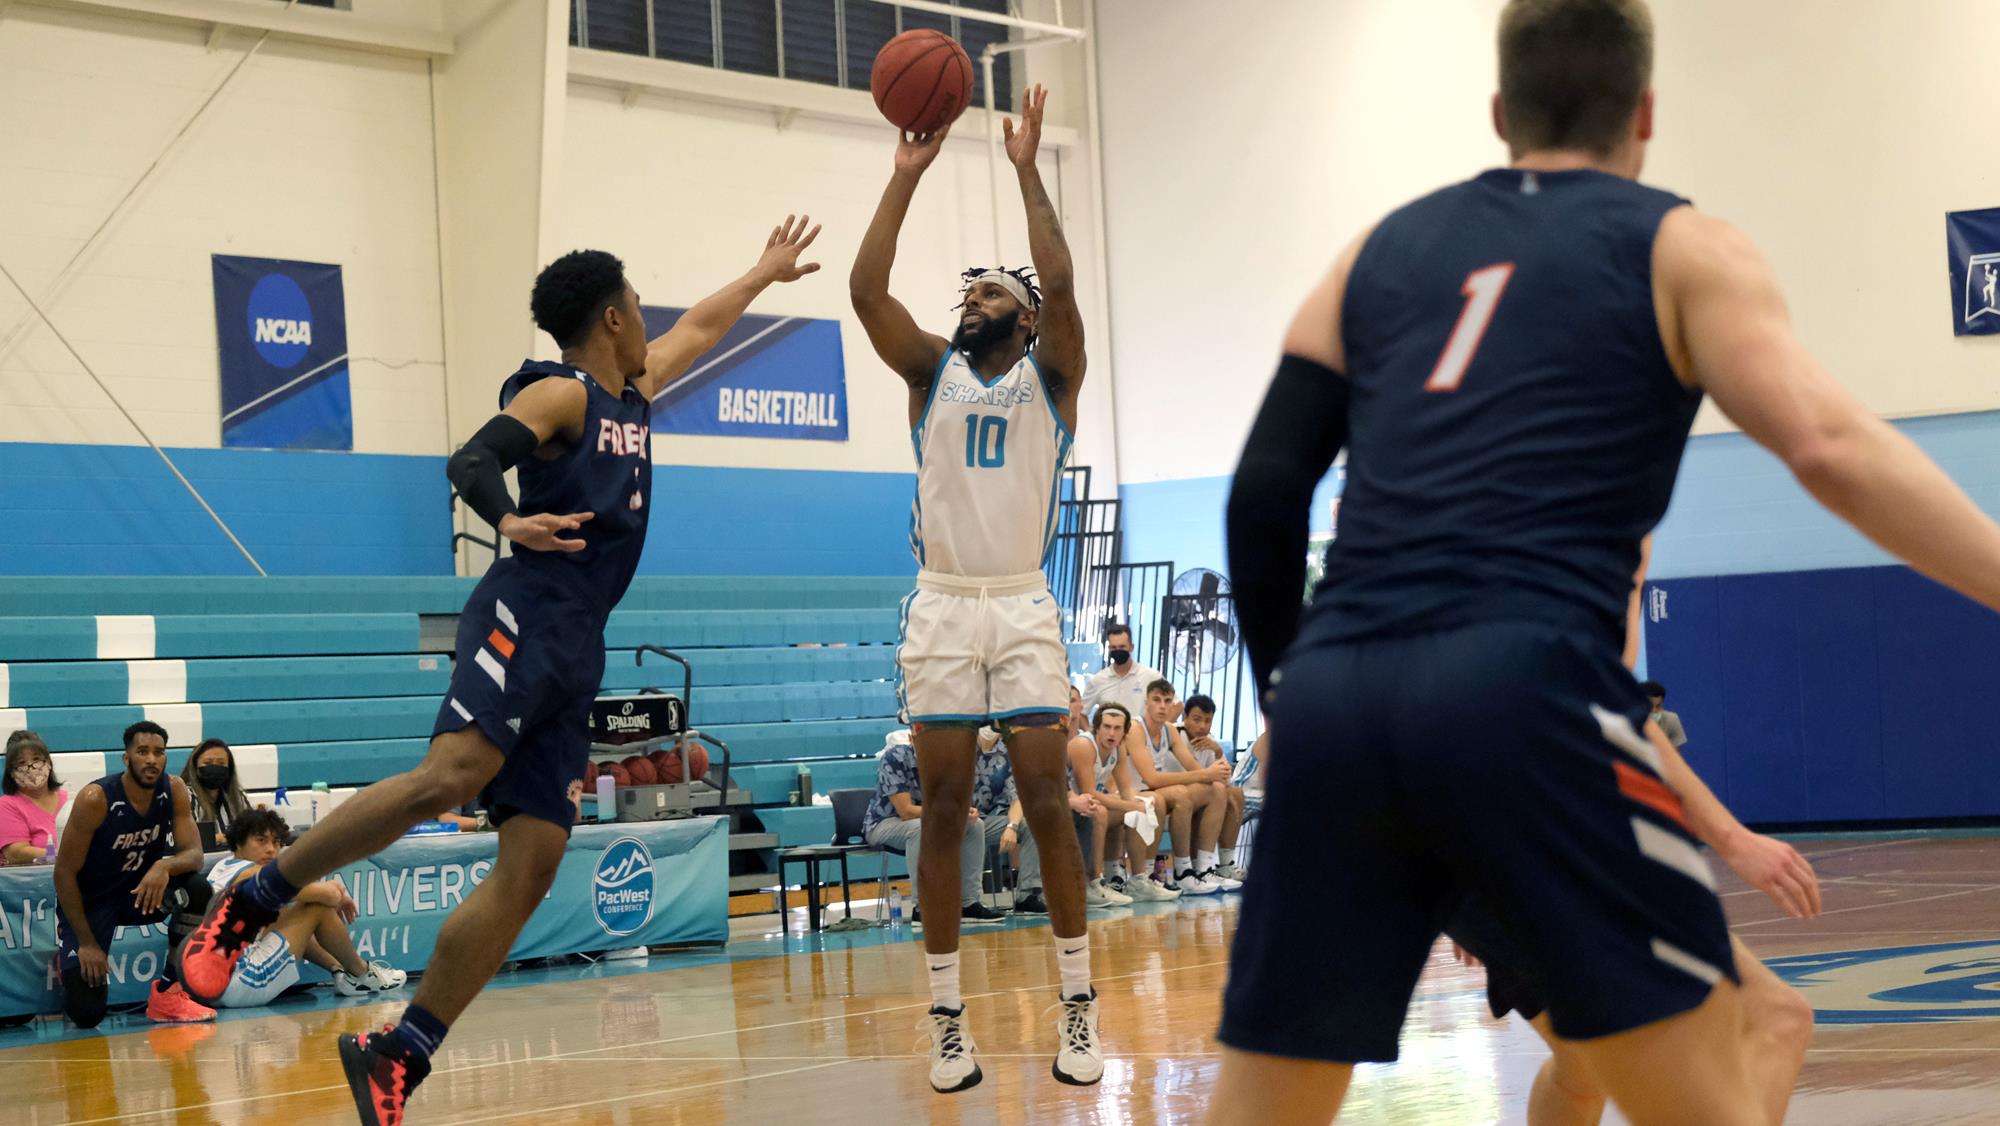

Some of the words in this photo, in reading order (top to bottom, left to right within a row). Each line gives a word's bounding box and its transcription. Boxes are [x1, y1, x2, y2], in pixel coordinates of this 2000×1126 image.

[255, 317, 312, 346] NCAA
[1424, 262, 1517, 392] 1
[718, 387, 838, 427] BASKETBALL
[966, 414, 1008, 468] 10
[606, 712, 651, 731] SPALDING
[112, 824, 160, 850] FRESO
[598, 888, 650, 905] PacWest
[603, 903, 643, 914] CONFERENCE
